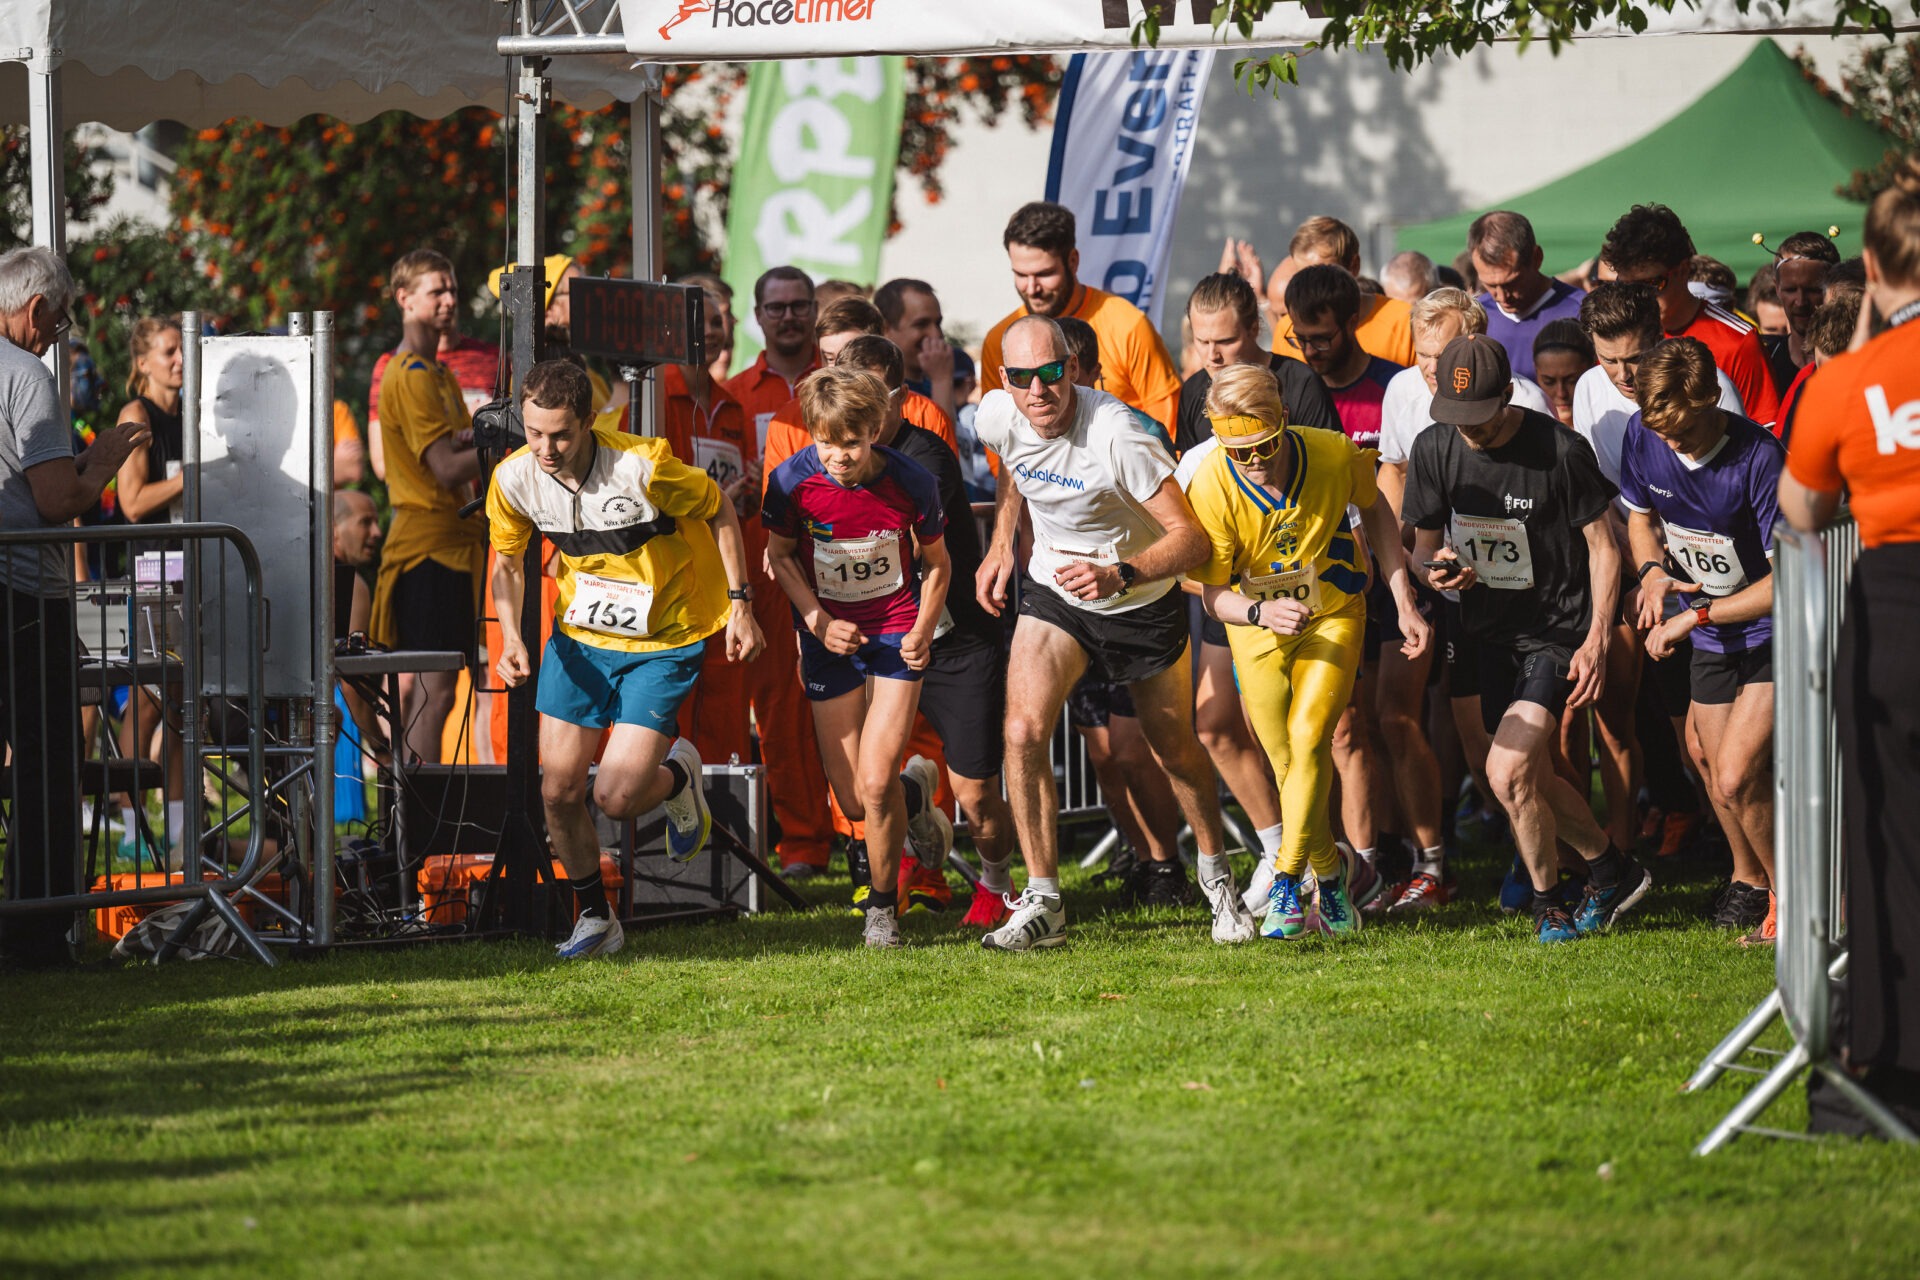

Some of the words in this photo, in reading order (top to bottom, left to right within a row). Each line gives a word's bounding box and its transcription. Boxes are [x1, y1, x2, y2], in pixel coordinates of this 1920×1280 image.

[712, 0, 875, 27] Racetimer
[1016, 463, 1085, 491] Qualcomm
[1513, 498, 1533, 510] FOI
[1465, 538, 1520, 563] 173
[1679, 547, 1731, 575] 166
[834, 556, 891, 583] 193
[861, 582, 898, 595] HealthCare
[569, 609, 576, 620] 1
[588, 600, 637, 631] 152
